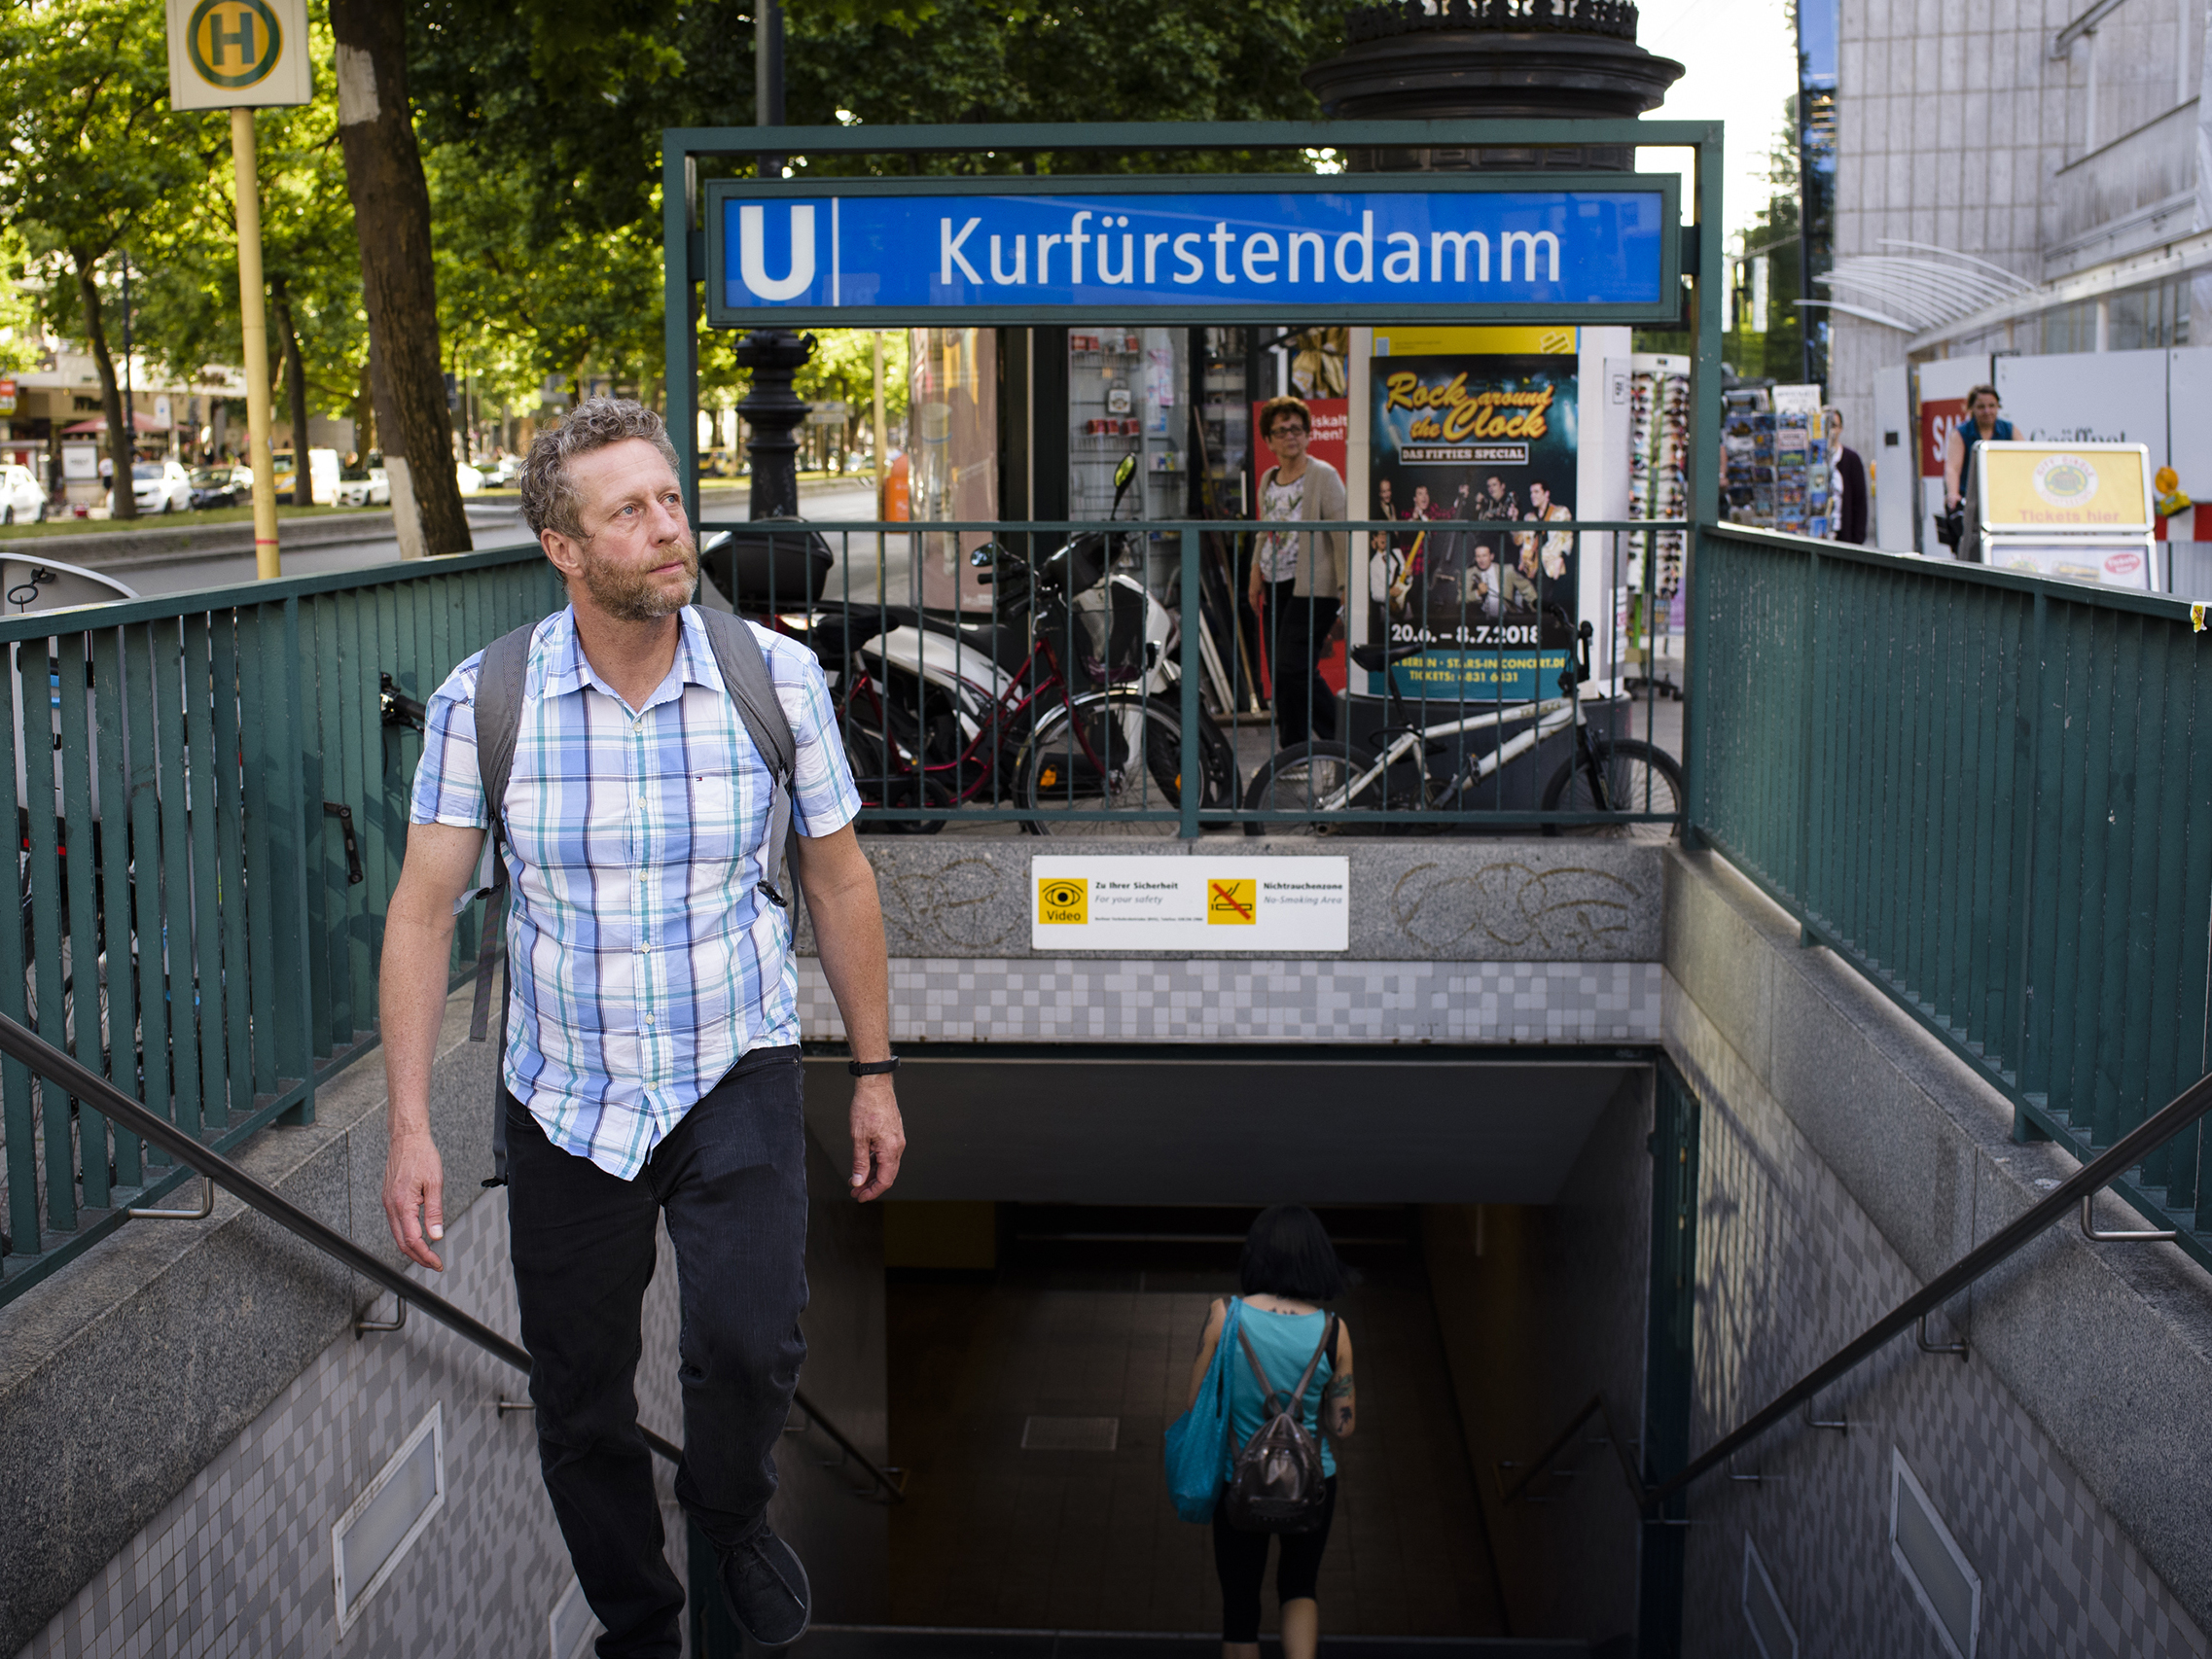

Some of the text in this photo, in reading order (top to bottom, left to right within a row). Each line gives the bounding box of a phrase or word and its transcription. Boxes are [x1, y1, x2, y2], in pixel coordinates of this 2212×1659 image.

[210, 13, 255, 65] H
[739, 204, 1560, 302] U Kurfürstendamm
[1386, 371, 1554, 412] Rock around
[1310, 414, 1348, 428] iskalt
[1410, 398, 1548, 442] the Clock
[1403, 448, 1525, 460] DAS FIFTIES SPECIAL
[2018, 509, 2120, 523] Tickets hier
[1391, 623, 1438, 644] 20.6.
[1455, 624, 1540, 645] 8.7.2018
[1095, 881, 1179, 890] Zu Ihrer Sicherheit
[1095, 895, 1163, 905] For your safety
[1264, 896, 1342, 906] No-Smoking Area
[1047, 909, 1082, 922] Video
